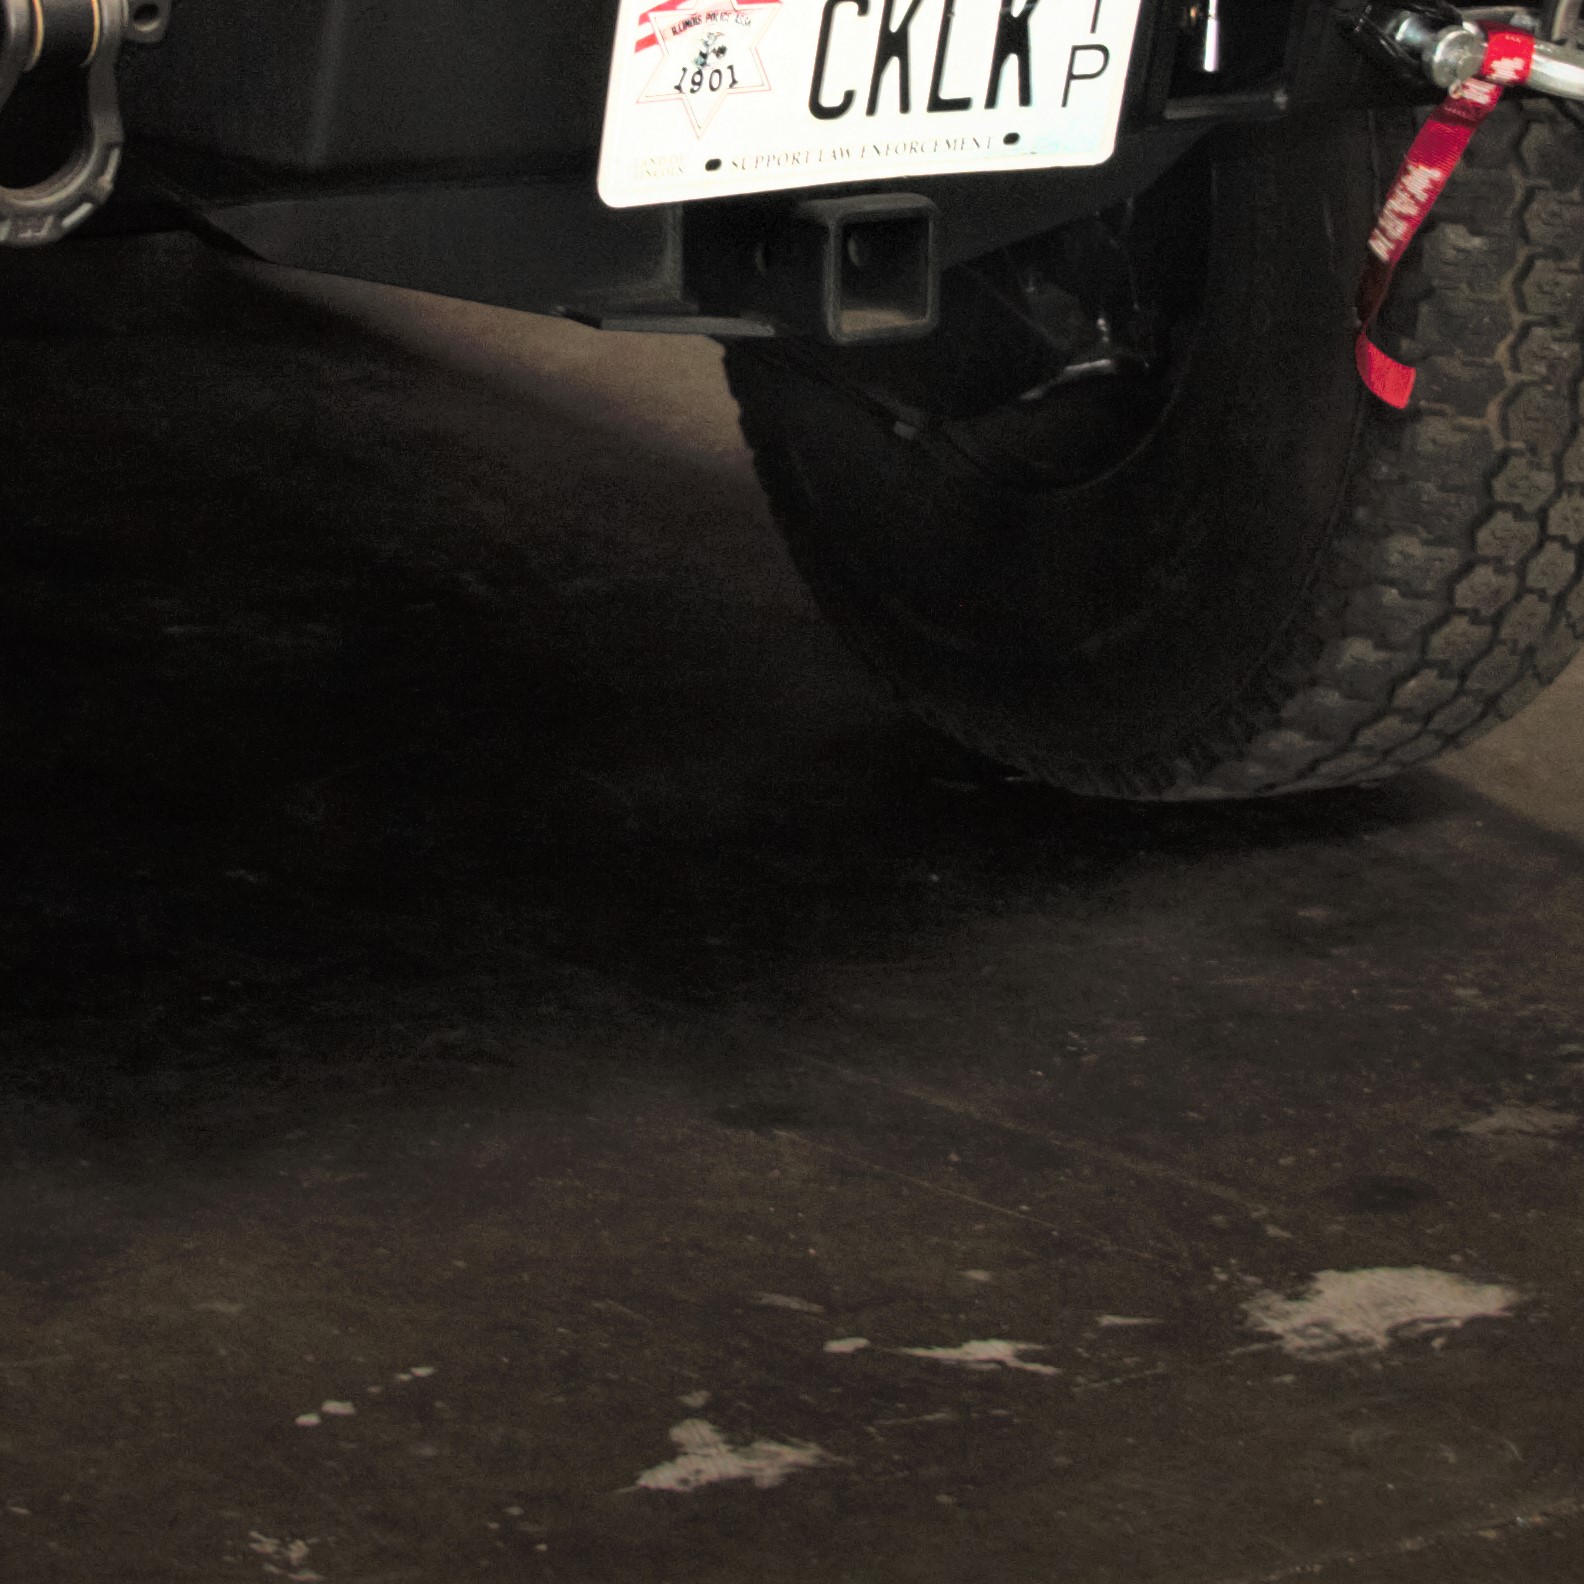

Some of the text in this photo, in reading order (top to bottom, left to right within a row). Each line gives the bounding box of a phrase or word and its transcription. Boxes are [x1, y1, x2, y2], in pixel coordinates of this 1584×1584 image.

[673, 63, 740, 94] 1901
[729, 136, 995, 172] SUPPORT LAW ENFORCEMENT
[1367, 163, 1444, 263] WARN
